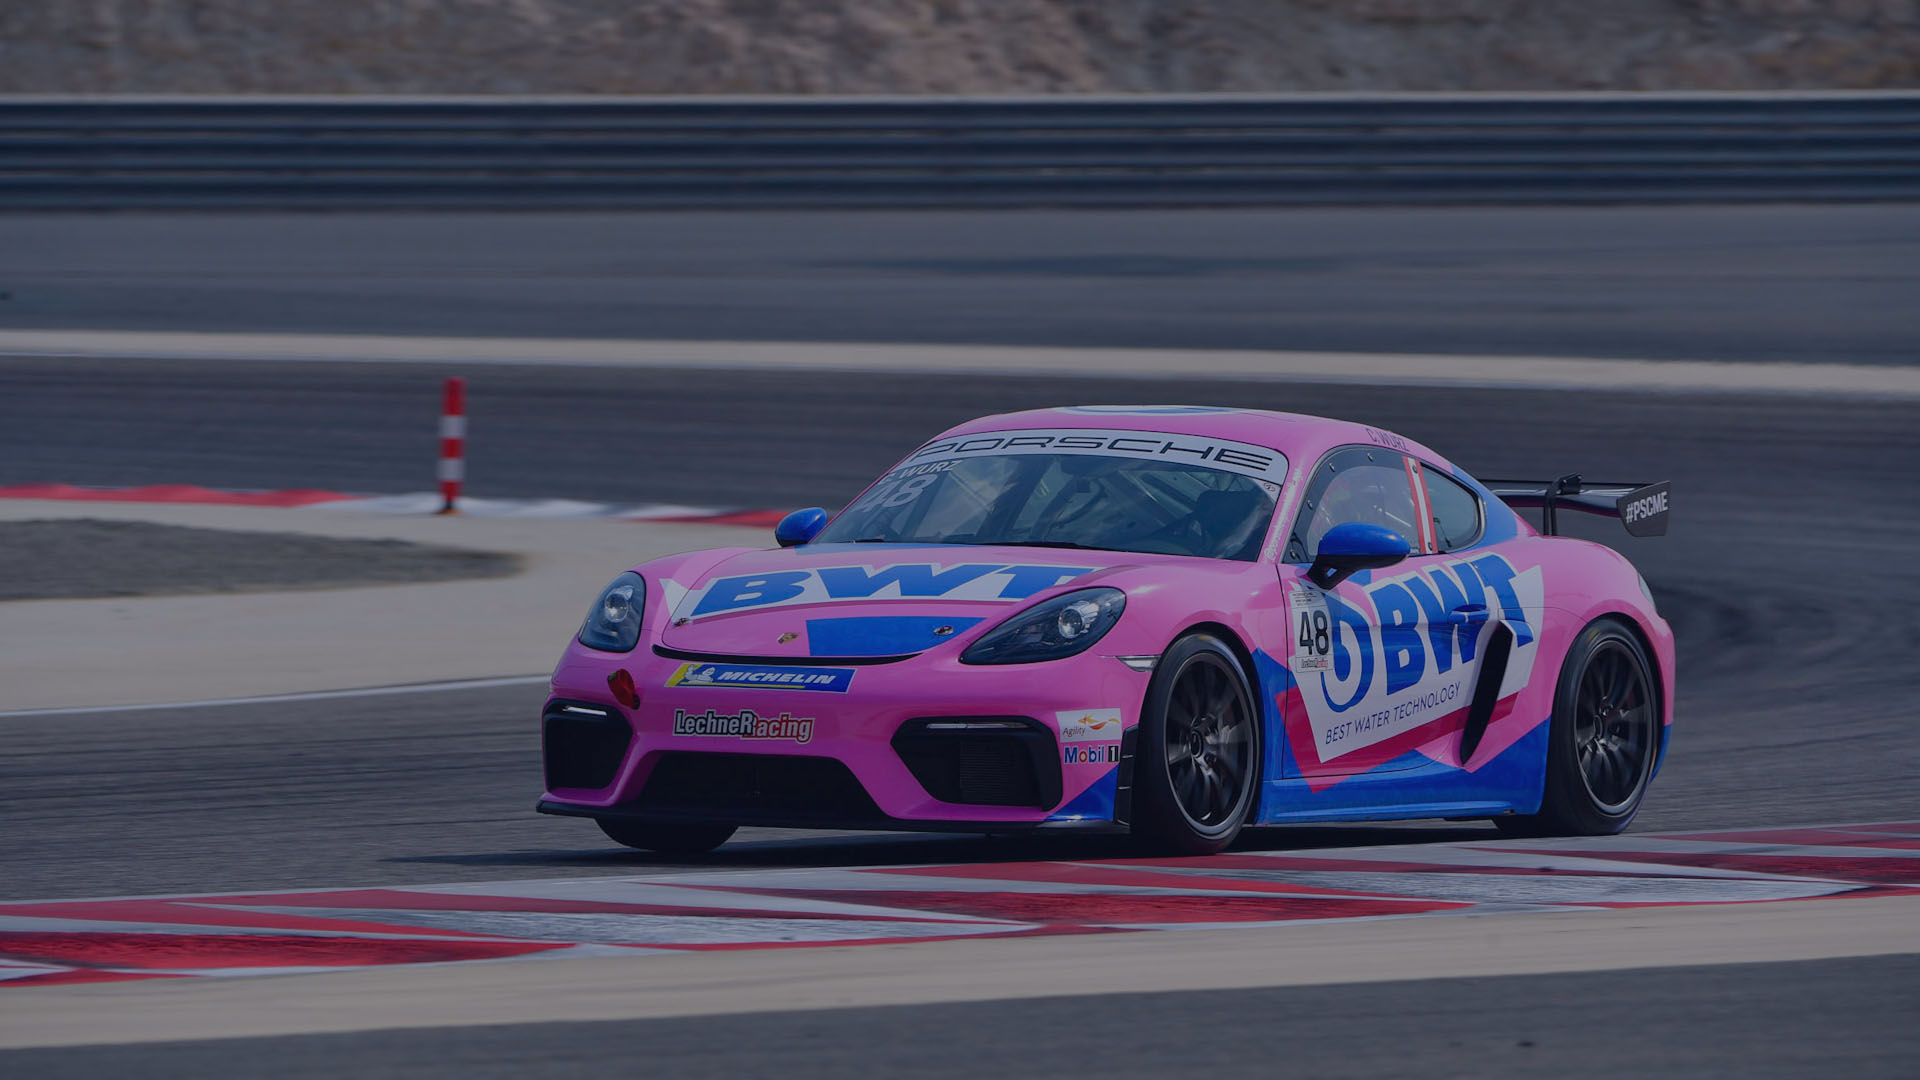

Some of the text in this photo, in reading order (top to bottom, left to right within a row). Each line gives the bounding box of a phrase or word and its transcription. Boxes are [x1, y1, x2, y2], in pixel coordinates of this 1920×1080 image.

[908, 436, 1273, 471] PORSCHE
[852, 474, 938, 512] 48
[1626, 491, 1668, 523] #PSCME
[692, 564, 1095, 616] BWT
[1300, 610, 1329, 655] 48
[1370, 555, 1534, 696] BWT
[718, 671, 836, 684] MICHELIN
[1325, 681, 1461, 745] BEST WATER TECHNOLOGY
[1063, 726, 1086, 737] Agility
[1064, 746, 1118, 763] Mobil 1
